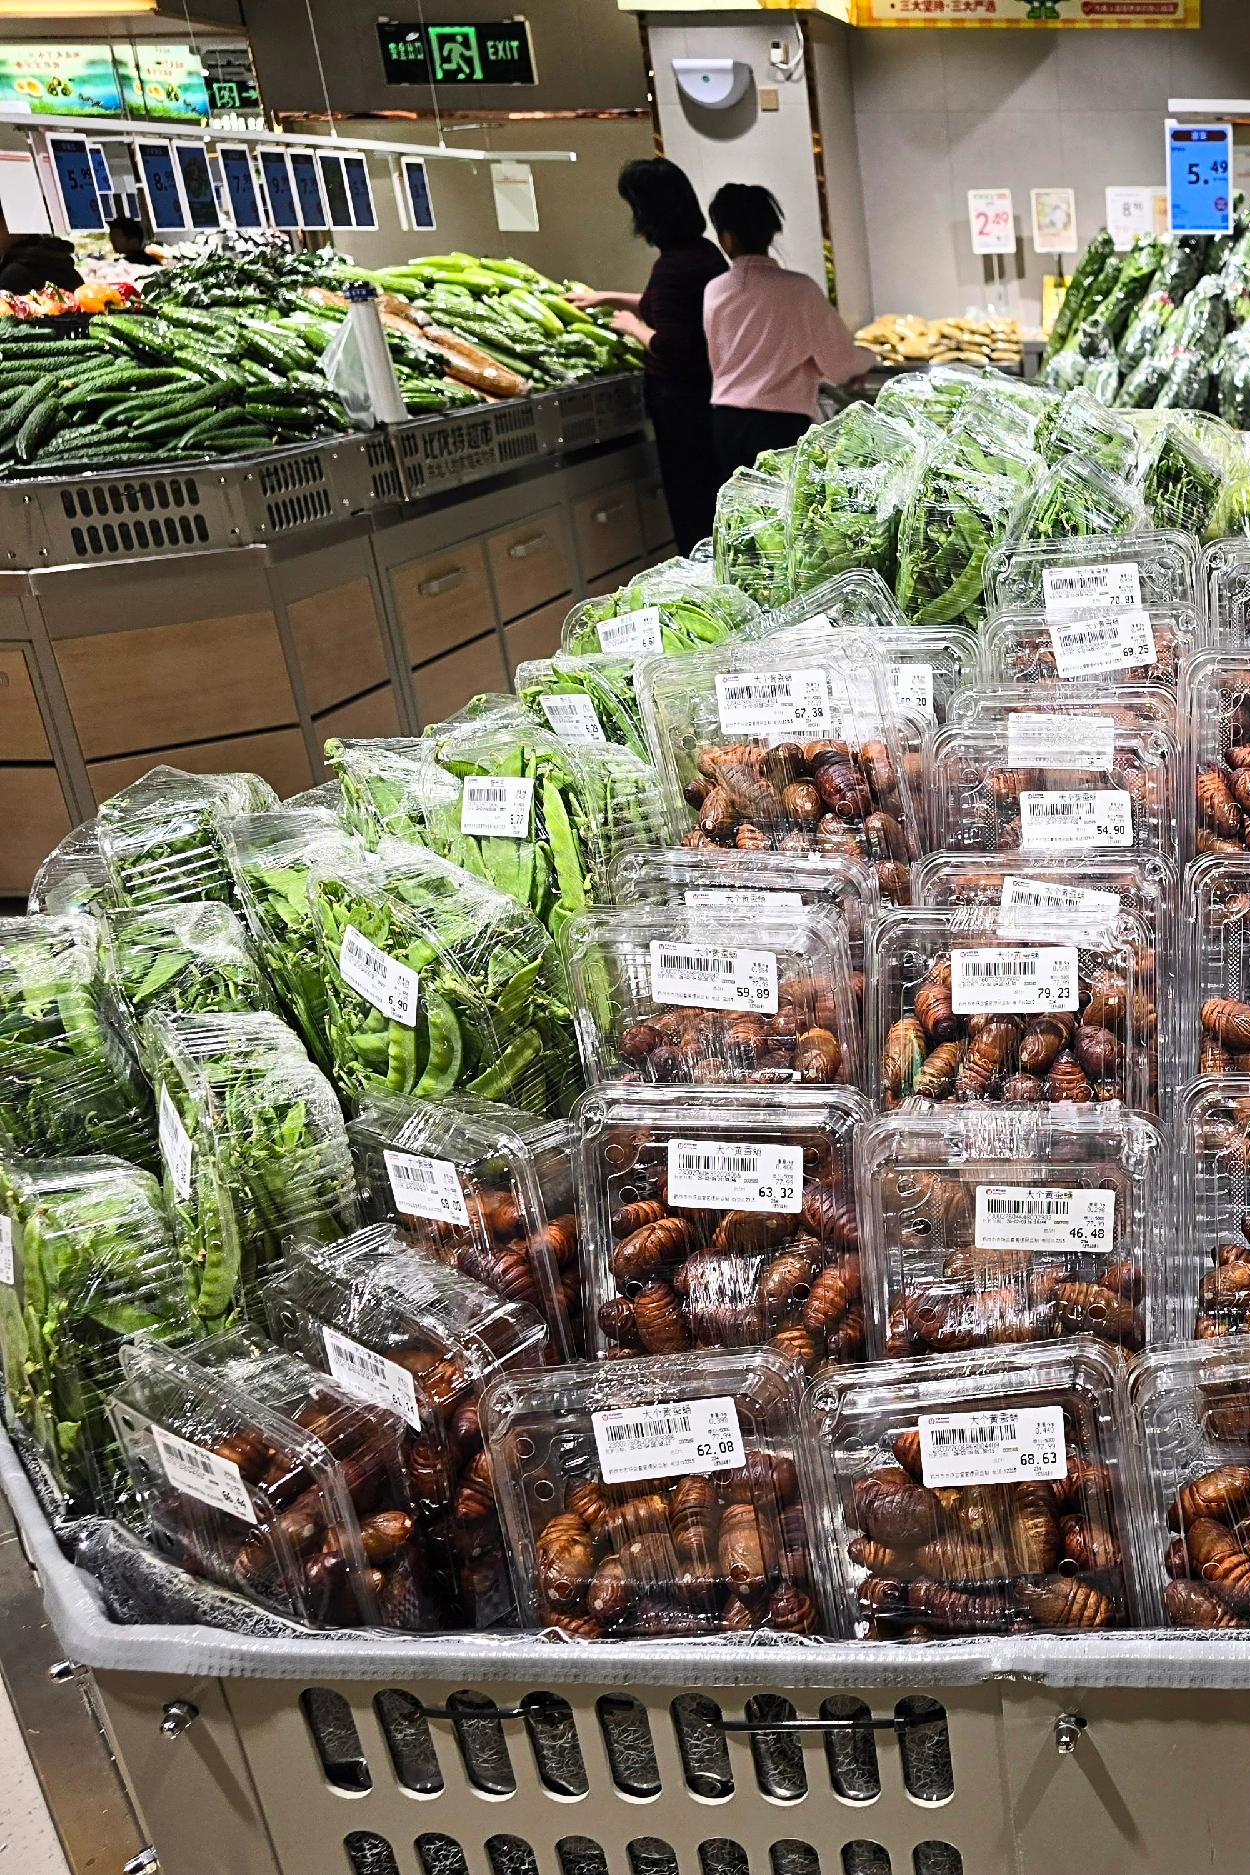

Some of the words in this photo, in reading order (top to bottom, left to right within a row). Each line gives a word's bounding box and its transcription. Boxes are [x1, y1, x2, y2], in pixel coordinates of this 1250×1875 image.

[486, 40, 519, 61] EXIT
[1187, 161, 1229, 185] 5.49
[1123, 645, 1149, 656] 69.25
[795, 709, 824, 719] 67.38
[1097, 826, 1125, 834] 54.90
[737, 987, 770, 999] 59.89
[1037, 988, 1070, 998] 79.23
[388, 995, 409, 1012] 6.90
[758, 1186, 794, 1199] 63.32
[1069, 1228, 1105, 1239] 46.48
[697, 1441, 734, 1456] 62.08
[1020, 1452, 1057, 1465] 68.63
